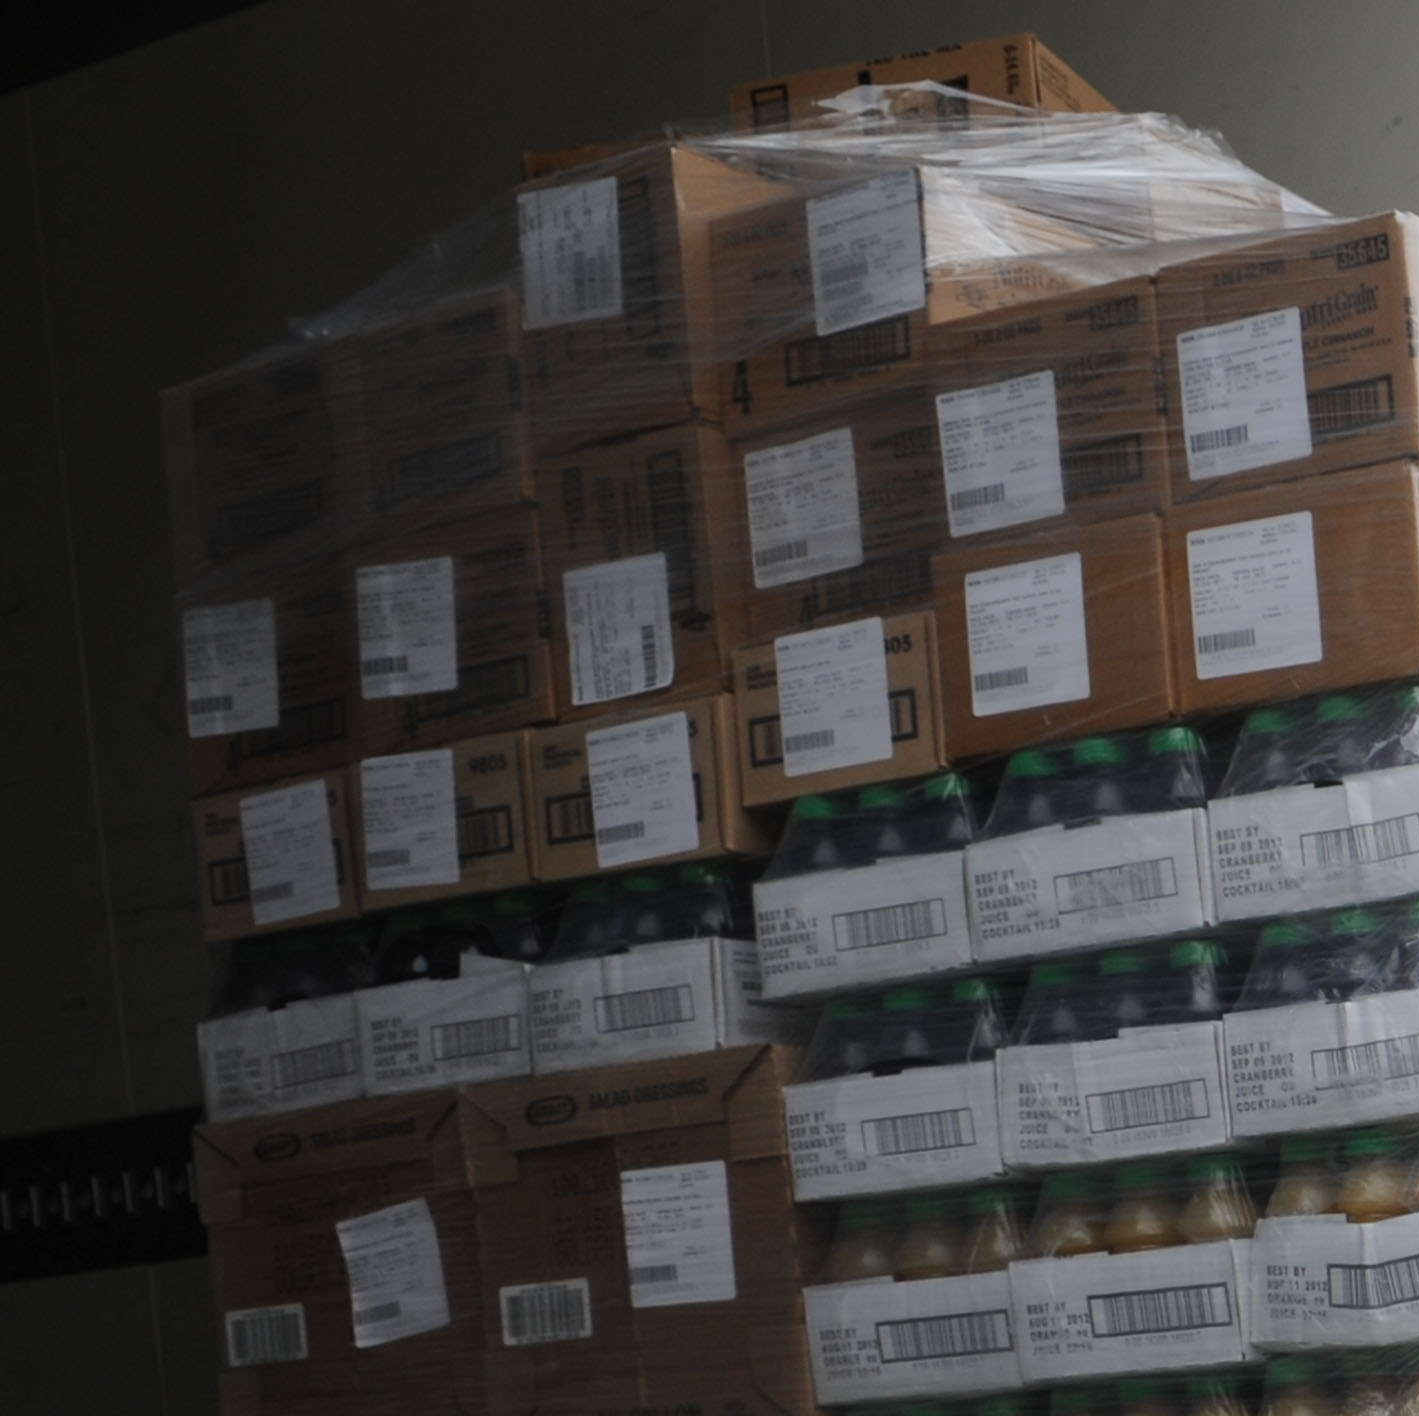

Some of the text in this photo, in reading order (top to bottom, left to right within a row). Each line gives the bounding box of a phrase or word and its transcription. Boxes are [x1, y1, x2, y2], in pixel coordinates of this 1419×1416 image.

[1339, 238, 1389, 269] 35645
[1321, 327, 1374, 347] CINNAMON
[731, 360, 753, 415] 4
[467, 753, 507, 775] 9805
[1217, 824, 1260, 841] BEST BY
[1218, 834, 1283, 855] SEP 2012
[1220, 849, 1283, 869] CRANBERRY
[975, 869, 1016, 885] BEST BY
[1220, 867, 1252, 882] JUICE
[976, 884, 995, 899] SEP
[1222, 879, 1275, 898] COCKTAIL
[982, 923, 1032, 940] COCKTAIL
[1231, 1041, 1272, 1057] BEST BY
[1232, 1052, 1295, 1071] SEP 2012
[1233, 1067, 1295, 1085] CRANBERRY
[634, 1077, 709, 1103] DRESSINGS
[1235, 1083, 1265, 1098] JUICE
[1236, 1096, 1288, 1114] COCKTAIL
[795, 1164, 841, 1180] COCKTAIL
[1266, 1264, 1306, 1277] BEST BY
[1305, 1281, 1328, 1293] 2012
[1026, 1301, 1050, 1316] BEST
